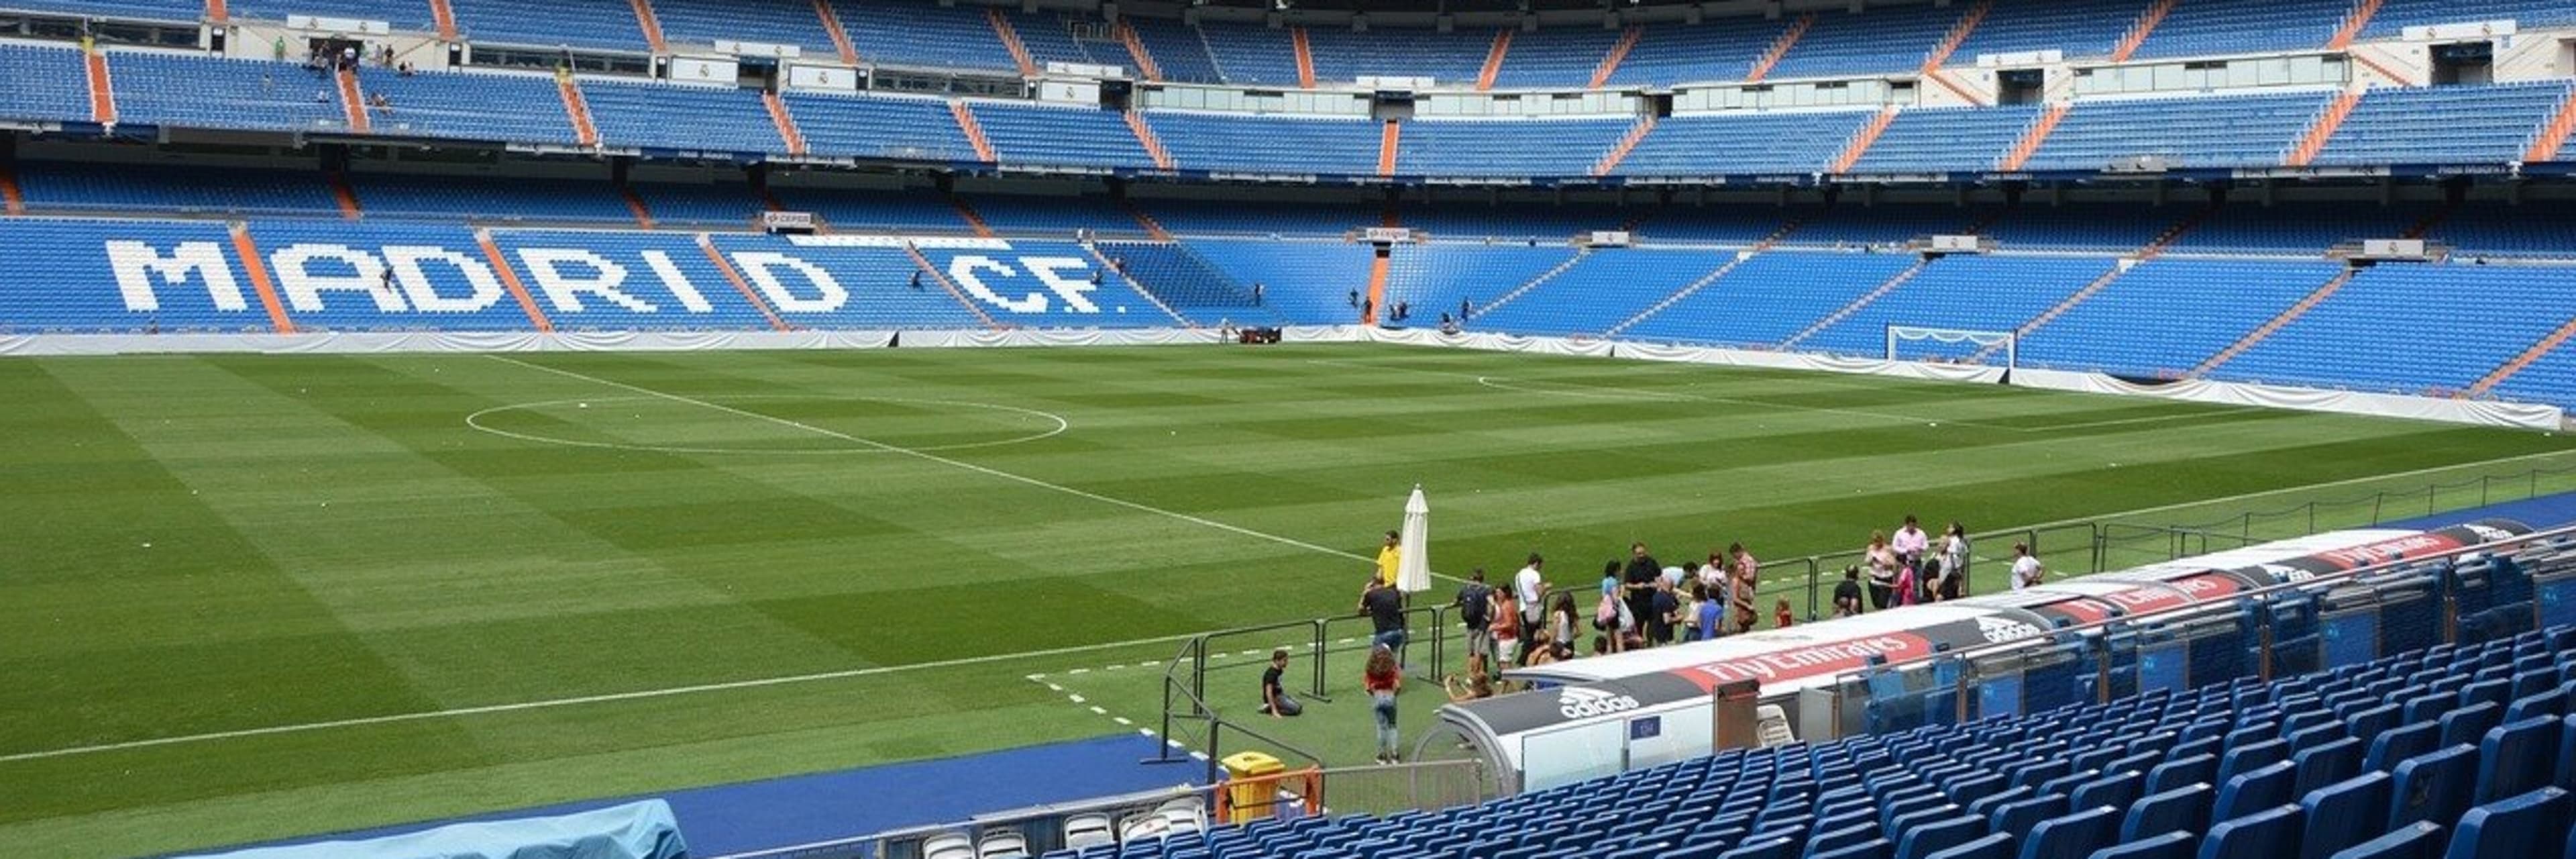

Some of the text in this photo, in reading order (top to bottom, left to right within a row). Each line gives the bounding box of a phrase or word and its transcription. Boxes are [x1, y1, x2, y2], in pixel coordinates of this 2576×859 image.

[105, 240, 851, 314] MADRID
[1697, 636, 1909, 680] Fly Emirates
[1560, 695, 1640, 719] adidas
